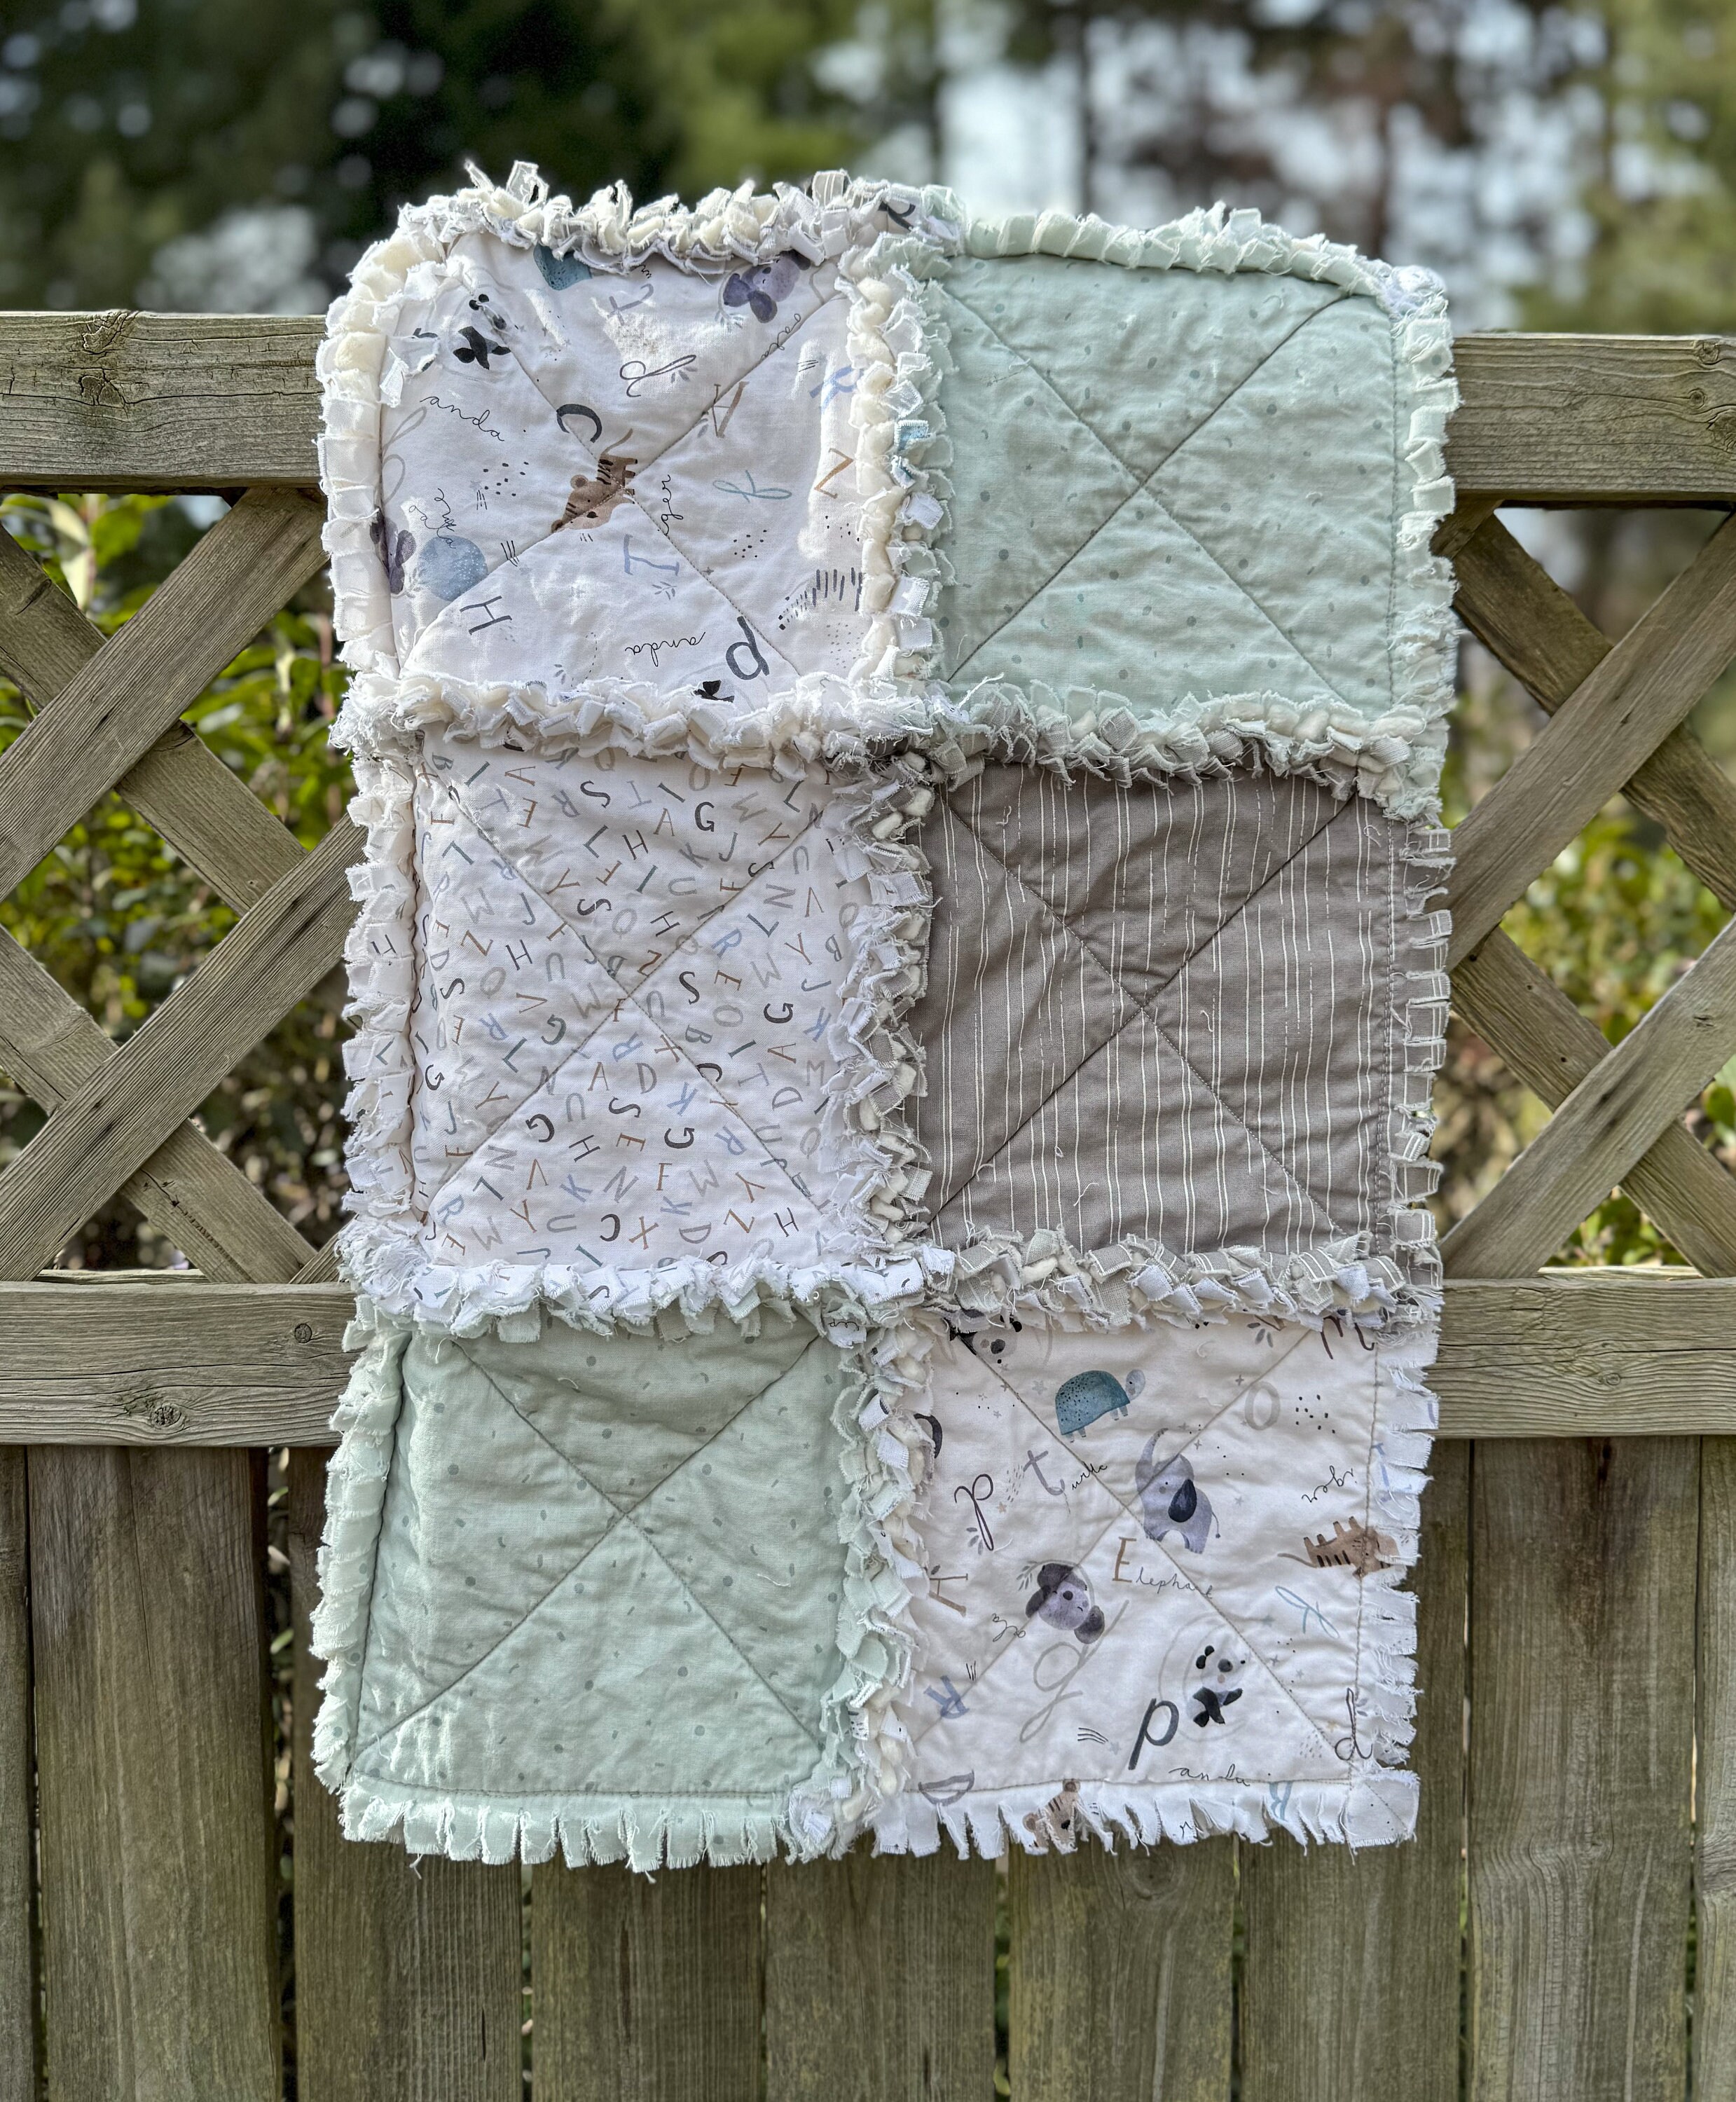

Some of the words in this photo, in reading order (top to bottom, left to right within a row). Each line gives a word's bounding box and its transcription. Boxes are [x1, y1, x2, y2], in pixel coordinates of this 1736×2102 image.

[420, 396, 505, 442] anda
[459, 595, 513, 636] H
[504, 766, 537, 787] A
[579, 779, 612, 809] S
[652, 807, 675, 837] A
[694, 800, 715, 832] G
[583, 824, 609, 859] L
[621, 829, 649, 861] H
[718, 831, 738, 863] J
[757, 821, 791, 847] Y
[678, 842, 710, 870] K
[546, 867, 581, 895] Y
[595, 860, 623, 886] F
[519, 892, 537, 926] J
[577, 898, 613, 916] S
[649, 910, 681, 937] H
[745, 912, 780, 938] L
[504, 939, 534, 972] H
[711, 927, 743, 959] R
[783, 931, 813, 966] Y
[439, 977, 466, 1000] S
[678, 970, 701, 1005] S
[714, 969, 743, 992] E
[478, 1012, 510, 1041] R
[763, 1002, 794, 1024] G
[540, 1014, 567, 1046] G
[684, 1024, 713, 1045] B
[654, 1033, 684, 1063] X
[767, 1042, 797, 1065] A
[424, 1064, 446, 1091] G
[587, 1061, 610, 1092] A
[635, 1062, 659, 1094] D
[474, 1080, 510, 1111] Y
[607, 1095, 642, 1119] S
[666, 1080, 699, 1117] K
[772, 1085, 804, 1112] D
[525, 1113, 556, 1143] G
[614, 1132, 647, 1153] E
[663, 1126, 696, 1150] G
[713, 1125, 748, 1156] R
[567, 1134, 601, 1163] H
[655, 1162, 674, 1192] F
[735, 1171, 767, 1204] Y
[436, 1193, 464, 1226] R
[509, 1198, 538, 1234] Y
[659, 1195, 694, 1217] K
[600, 1213, 621, 1243] C
[628, 1216, 659, 1251] X
[678, 1221, 712, 1244] D
[773, 1206, 799, 1238] H
